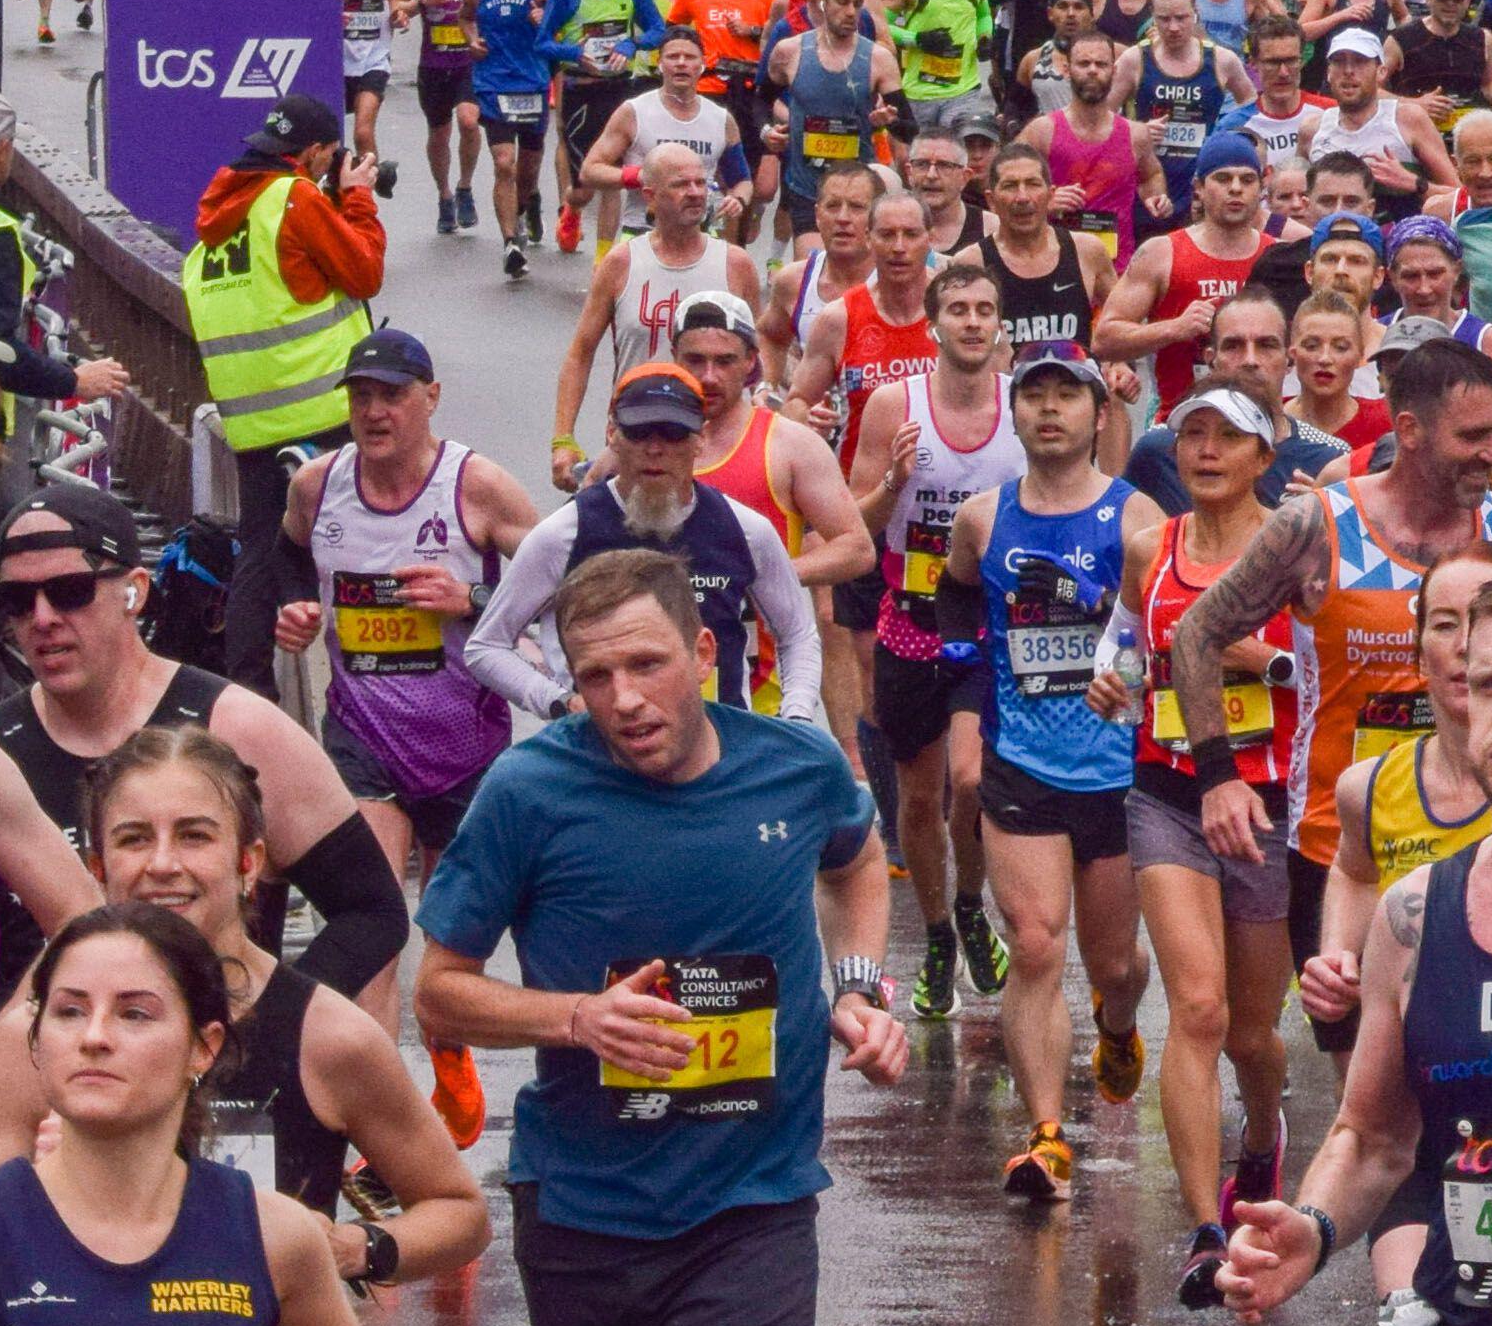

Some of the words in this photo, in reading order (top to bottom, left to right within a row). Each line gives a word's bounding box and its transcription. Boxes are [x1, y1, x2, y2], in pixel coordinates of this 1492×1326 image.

[137, 39, 216, 88] tcs
[1155, 85, 1202, 100] CHRIS
[1198, 281, 1237, 297] TEAM
[1001, 314, 1077, 344] CARLO
[862, 357, 939, 378] CLOWN
[357, 617, 418, 643] 2892
[1347, 628, 1418, 645] Muscul
[1347, 647, 1419, 664] Dystrop
[680, 968, 718, 979] TATA
[680, 978, 767, 993] CONSULTANCY
[680, 996, 738, 1007] SERVICES
[699, 1099, 758, 1114] balance
[150, 1280, 252, 1300] WAVERLEY
[152, 1297, 254, 1318] HARRIERS
